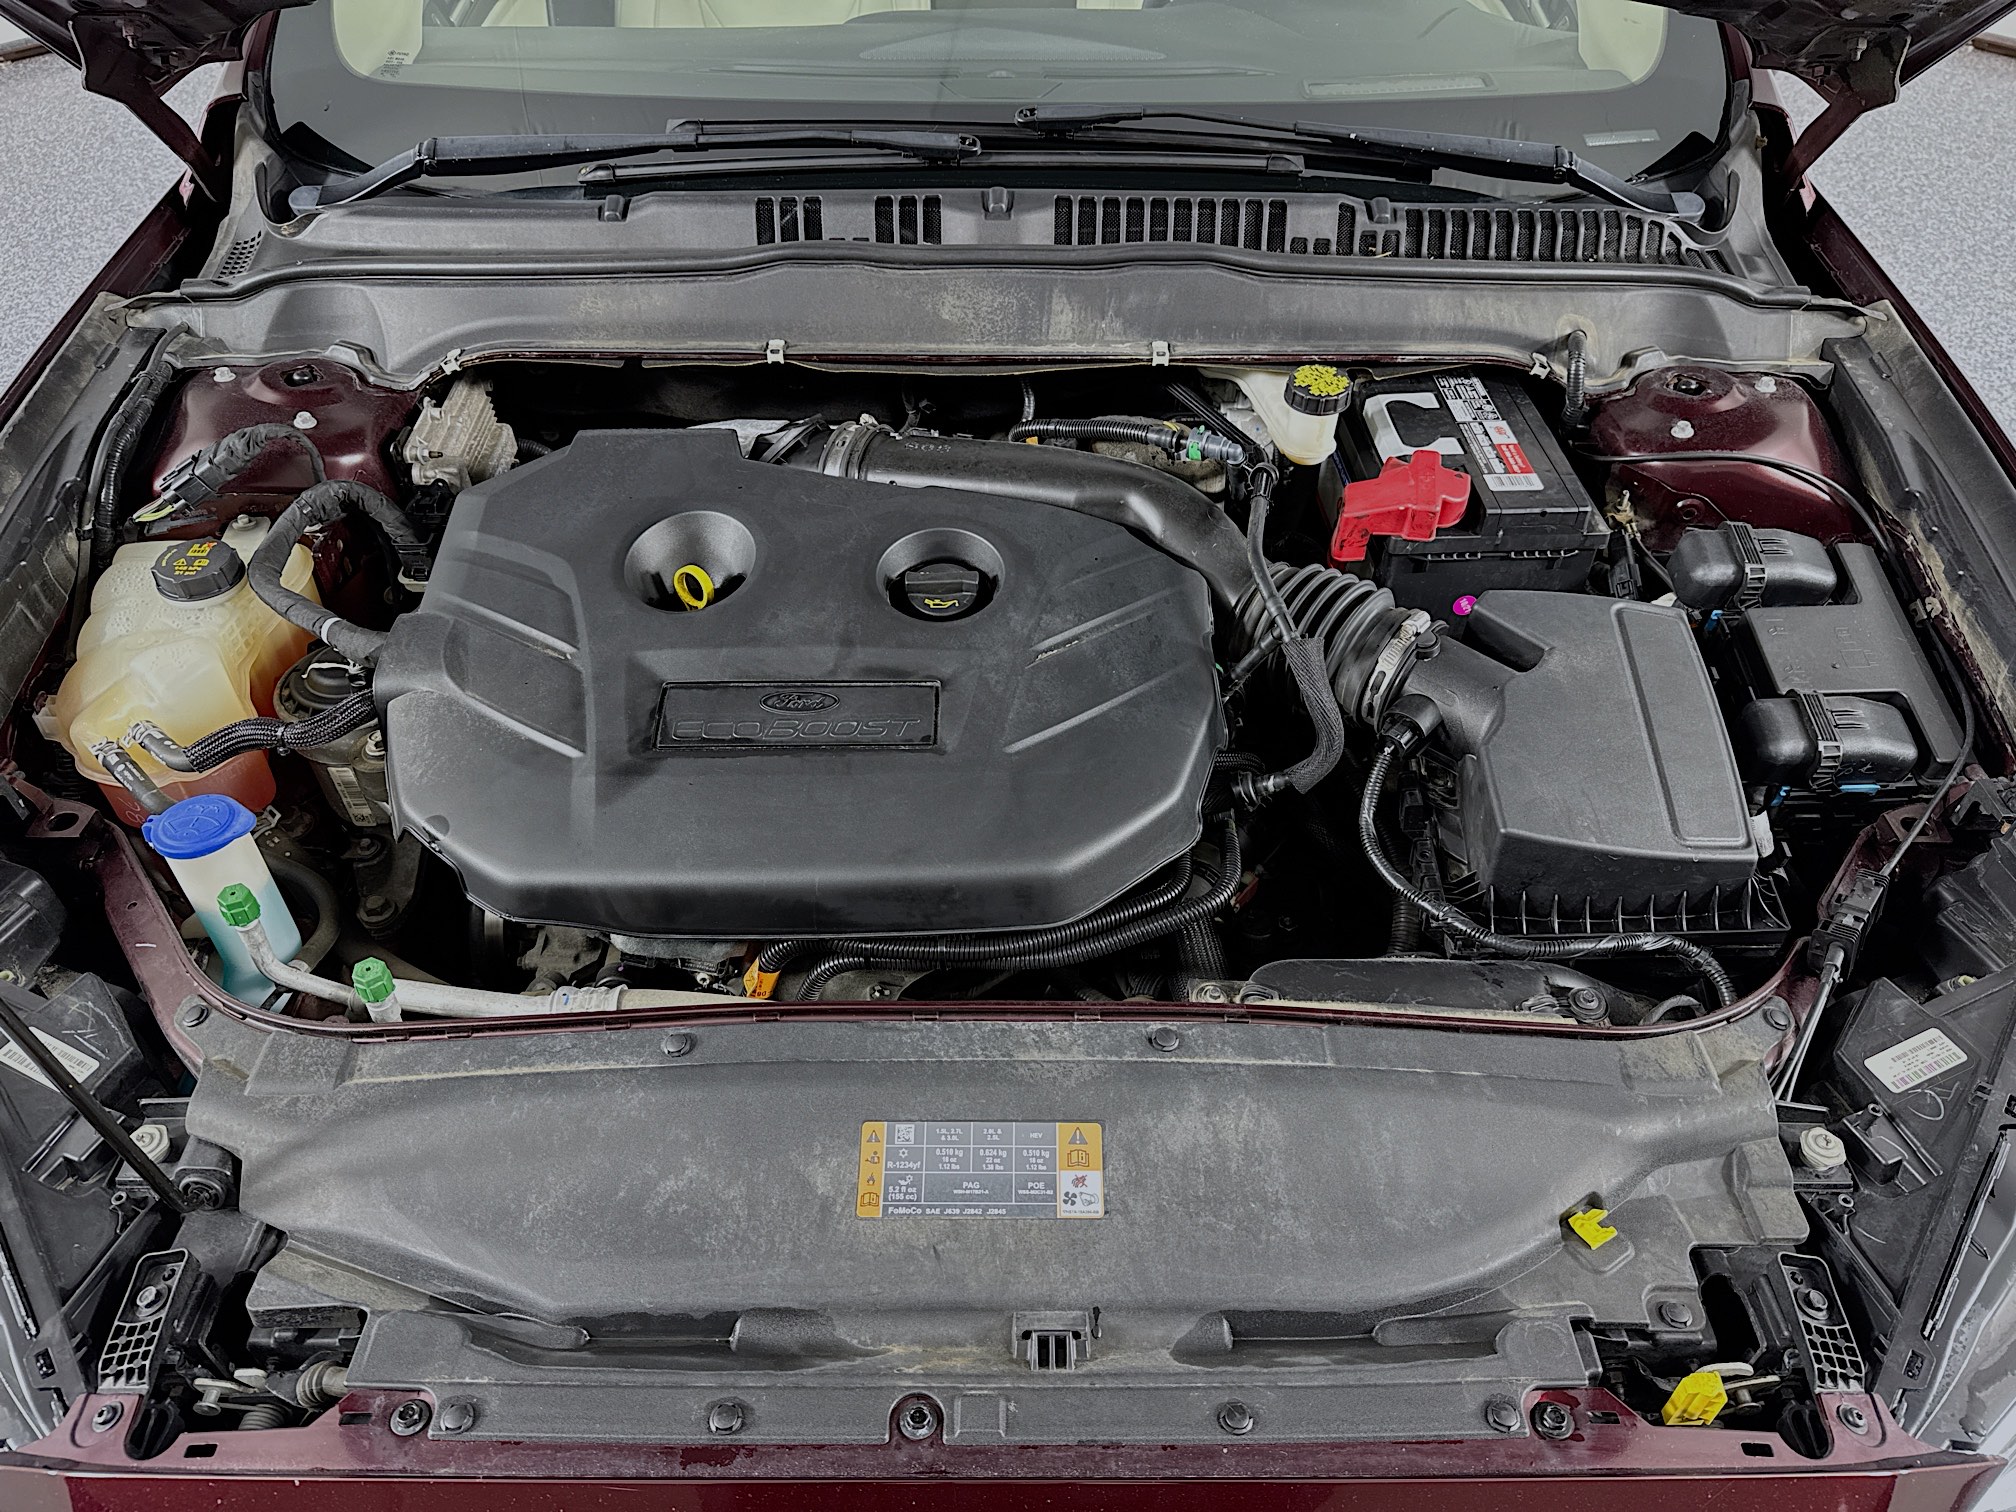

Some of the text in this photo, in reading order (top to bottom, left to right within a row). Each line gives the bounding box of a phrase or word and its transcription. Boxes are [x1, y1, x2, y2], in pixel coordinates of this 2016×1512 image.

[773, 692, 827, 710] Ford
[935, 1148, 964, 1157] 0.510 kg
[998, 1149, 1007, 1158] kg
[1022, 1149, 1050, 1158] 0.510 kg
[887, 1161, 921, 1170] R-1234yf
[962, 1181, 980, 1189] PAG
[1027, 1181, 1045, 1190] POE
[888, 1193, 918, 1201] (155 cc)
[888, 1206, 922, 1215] FoMoCo
